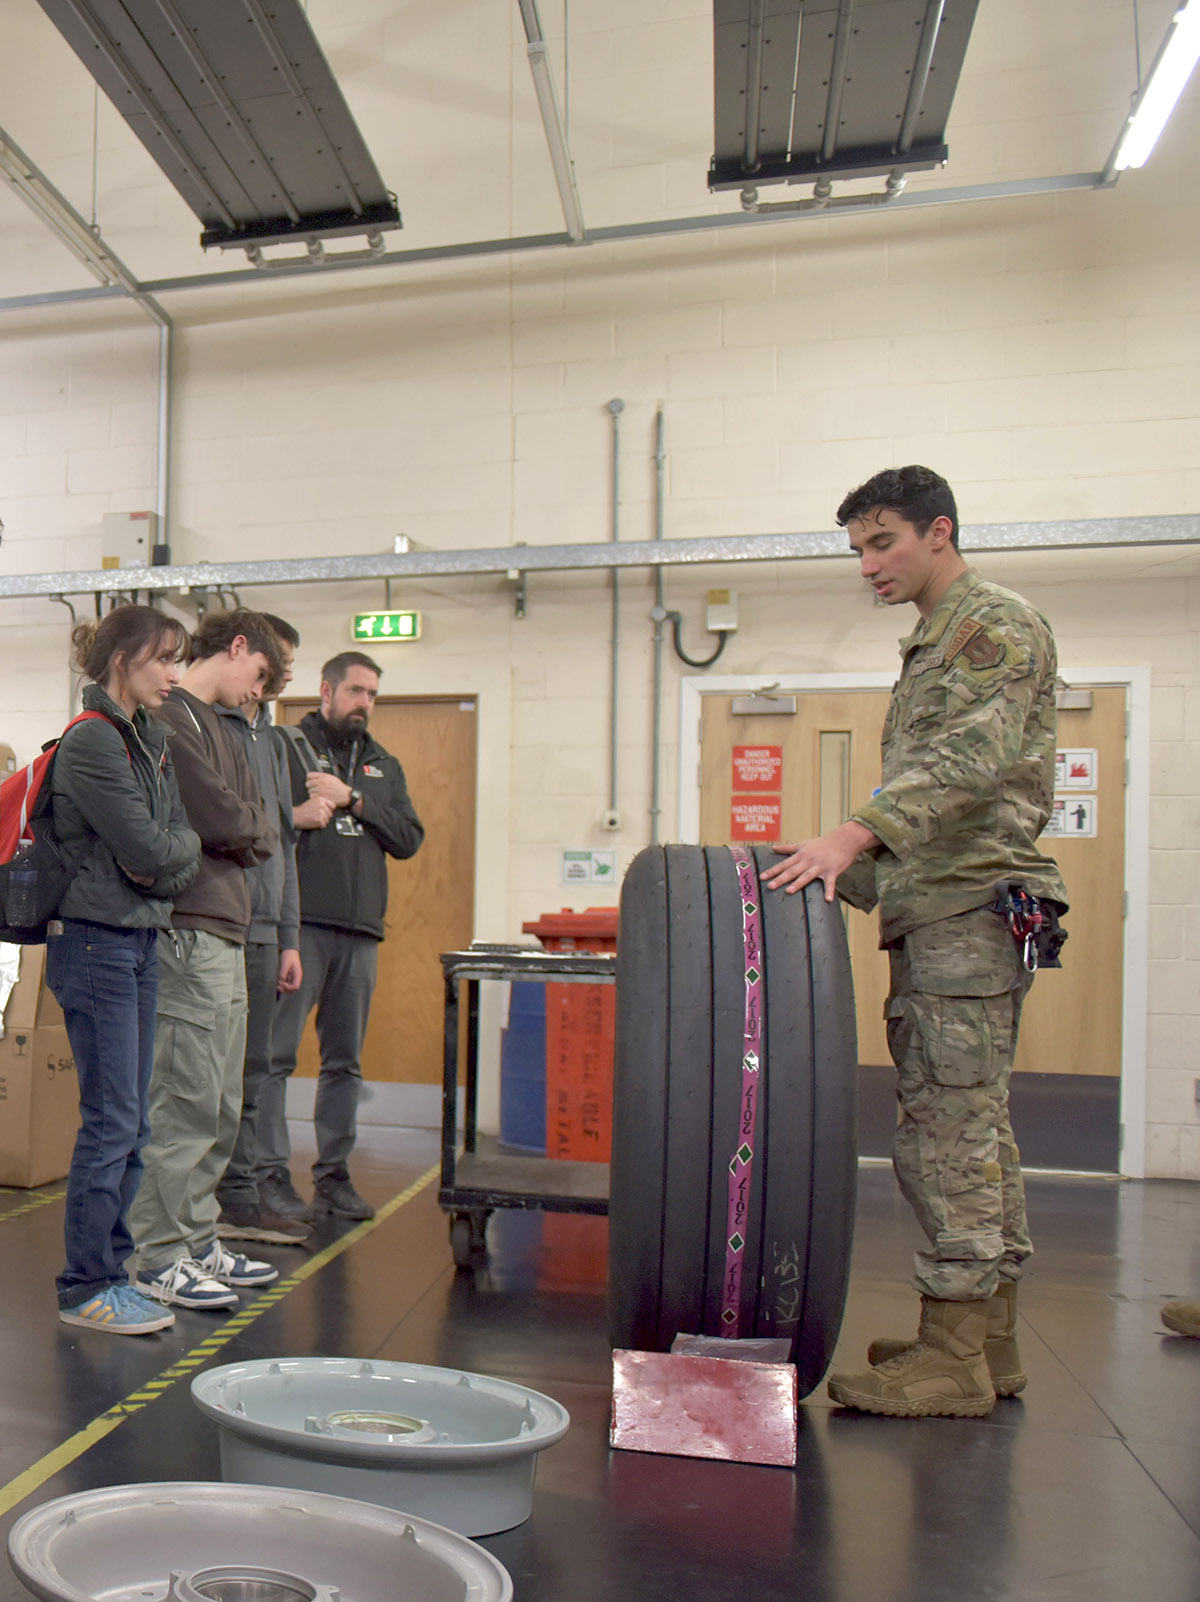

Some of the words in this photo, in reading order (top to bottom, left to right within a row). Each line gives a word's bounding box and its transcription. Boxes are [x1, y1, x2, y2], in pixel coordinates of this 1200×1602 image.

[744, 749, 770, 757] DANGER
[732, 805, 779, 815] HAZARDOUS
[735, 814, 775, 824] MATERIAL
[747, 923, 757, 961] 2017
[743, 1084, 754, 1135] 2017
[733, 1177, 748, 1225] 2017
